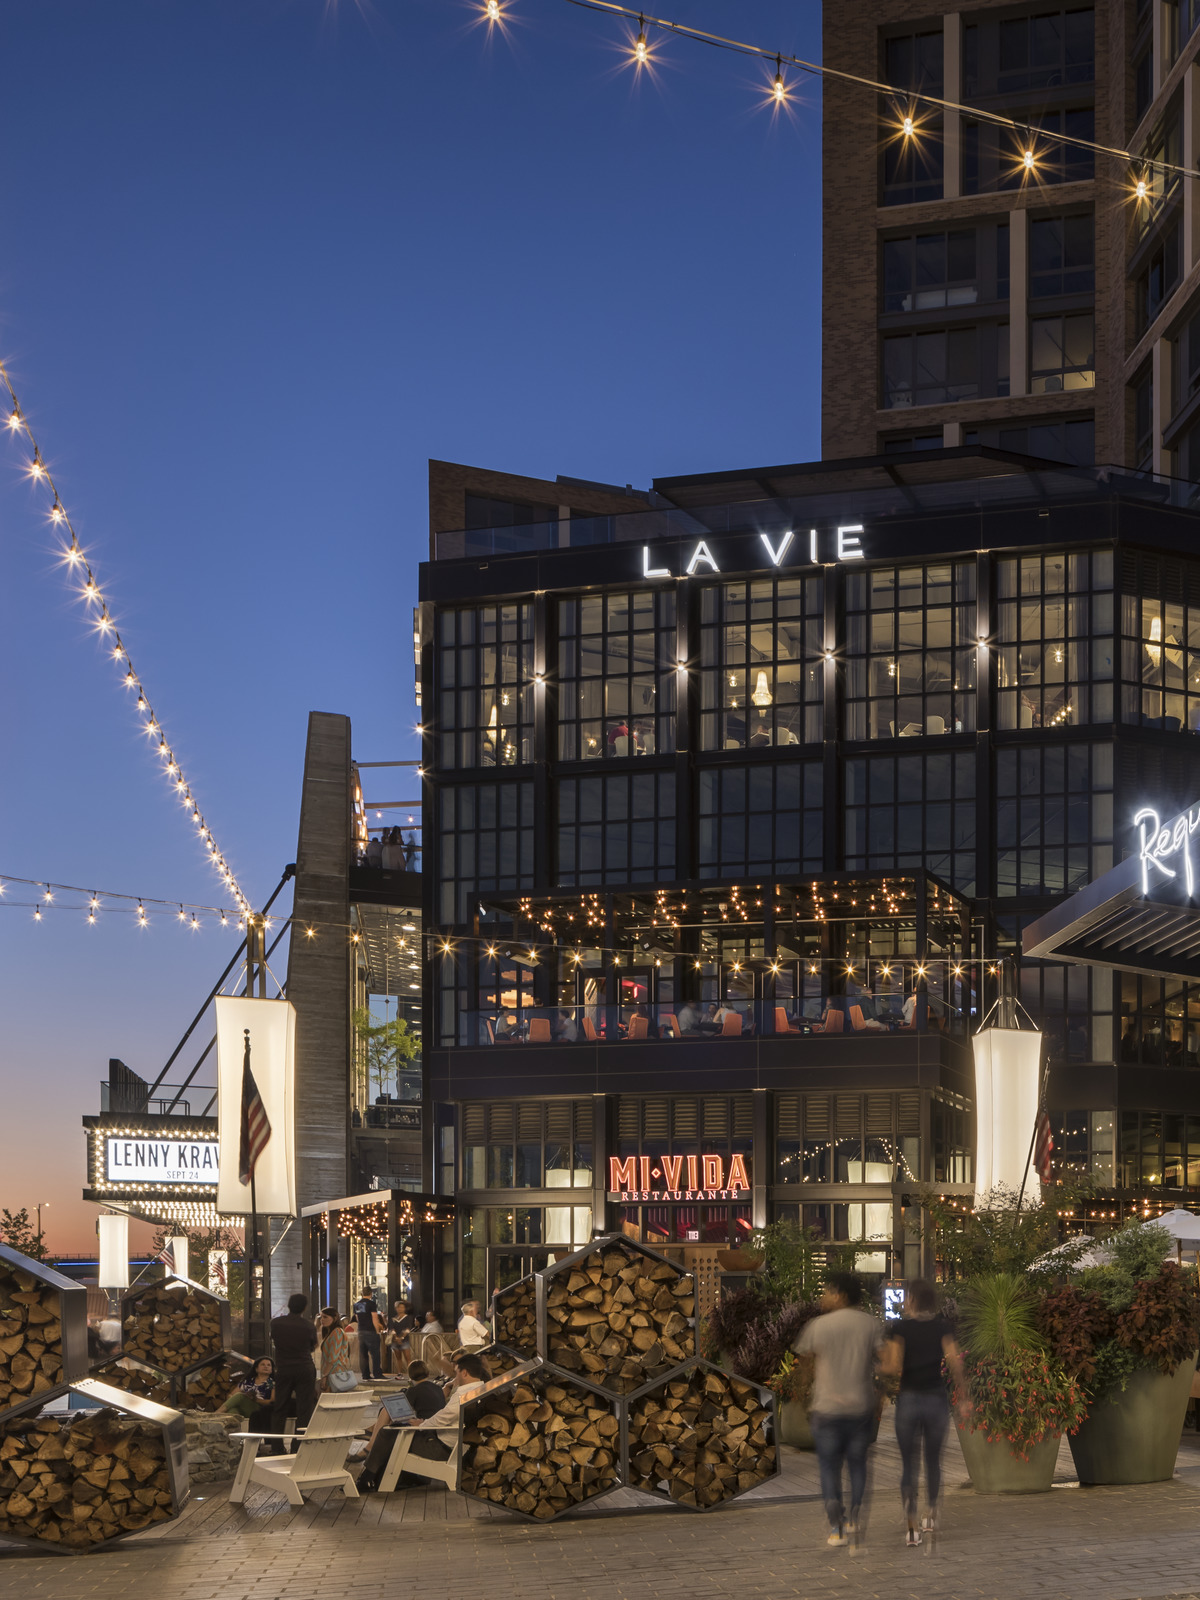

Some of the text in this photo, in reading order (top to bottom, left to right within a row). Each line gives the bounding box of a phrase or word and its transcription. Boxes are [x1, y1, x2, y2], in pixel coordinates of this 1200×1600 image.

[643, 525, 864, 578] LA VIE
[114, 1142, 170, 1168] LENNY
[166, 1171, 199, 1180] SEPT 24
[621, 1189, 739, 1201] RESTAURANTE
